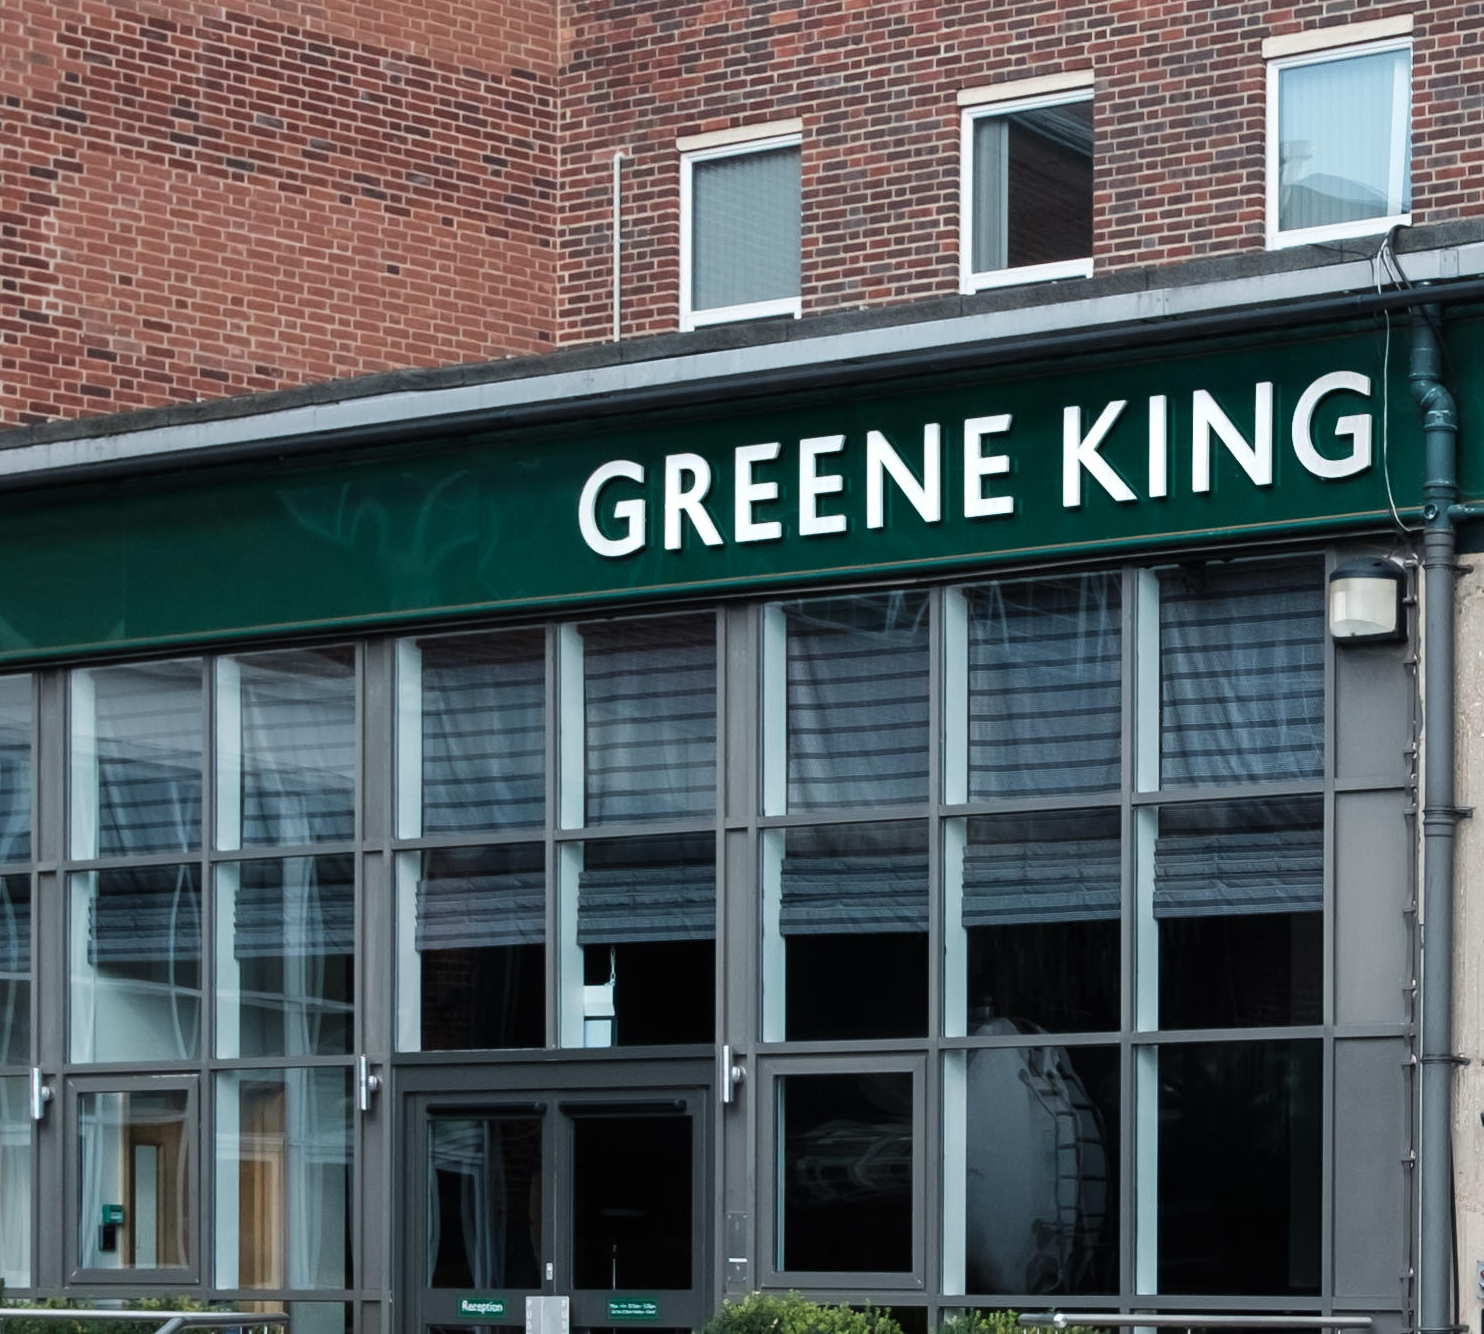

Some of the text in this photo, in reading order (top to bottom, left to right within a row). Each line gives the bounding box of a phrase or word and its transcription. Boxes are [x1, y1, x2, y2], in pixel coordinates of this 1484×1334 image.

[578, 370, 1373, 558] GREENE KING
[461, 1299, 504, 1315] Reception
